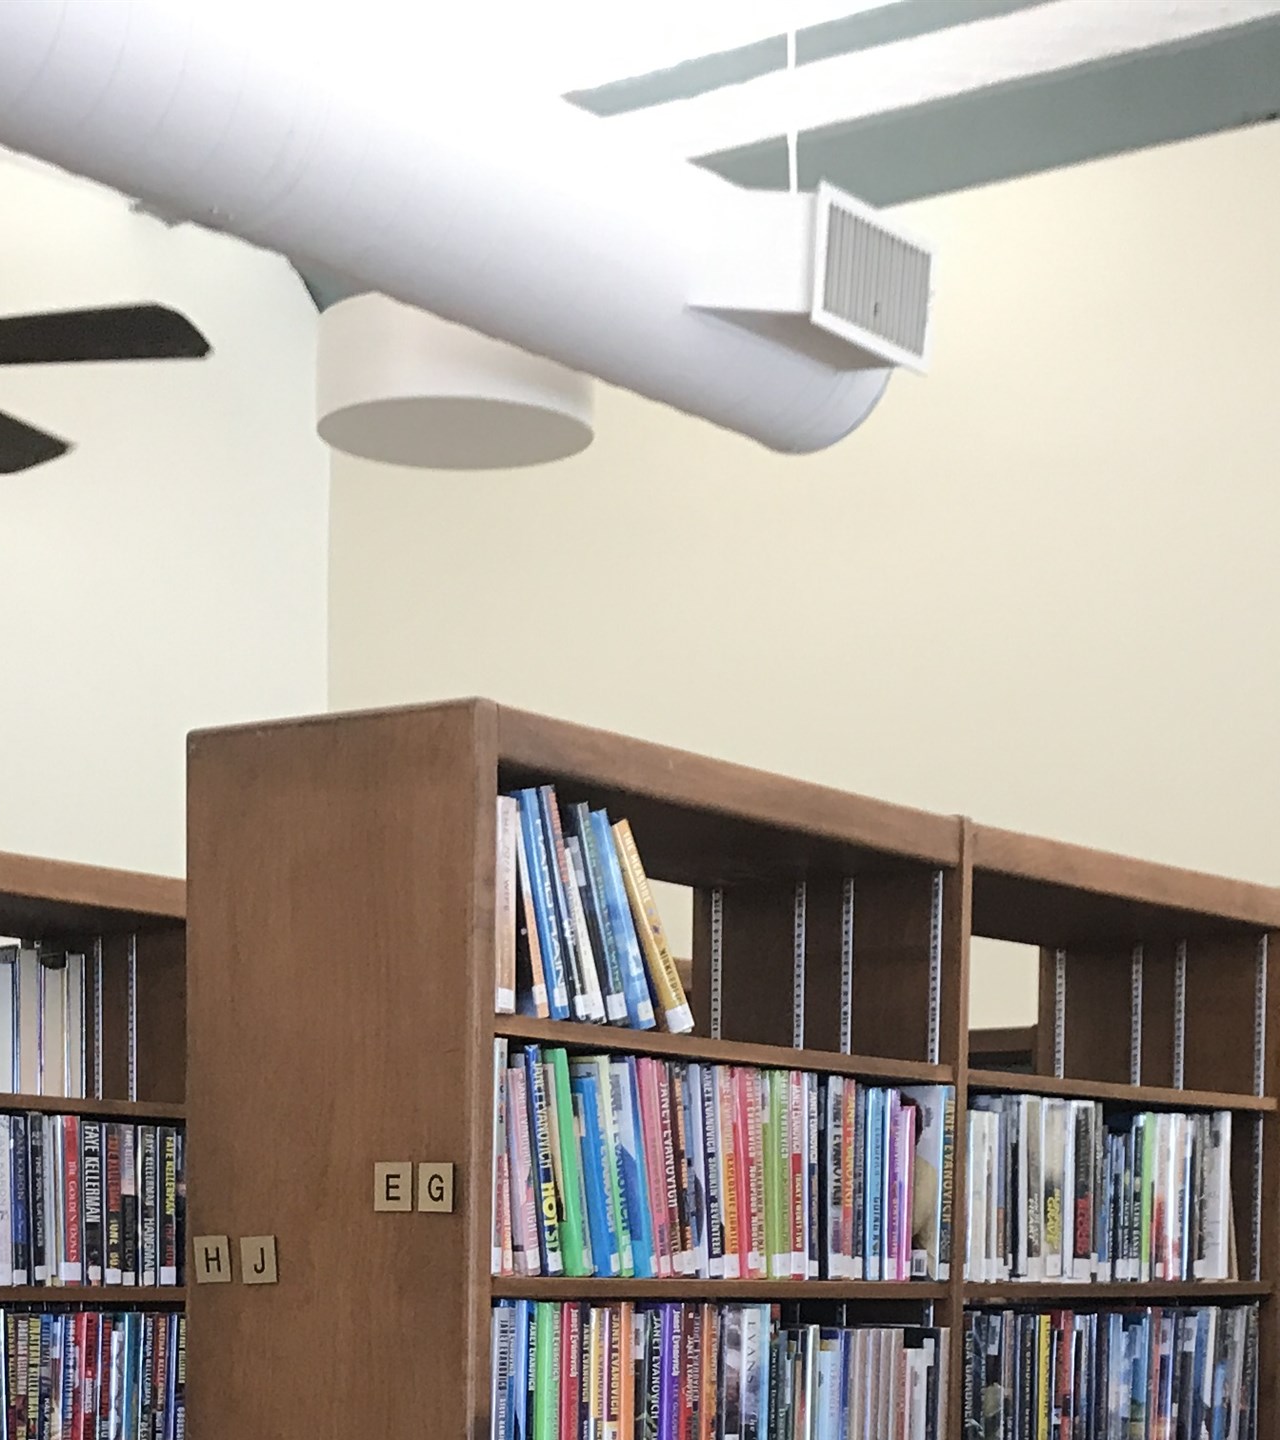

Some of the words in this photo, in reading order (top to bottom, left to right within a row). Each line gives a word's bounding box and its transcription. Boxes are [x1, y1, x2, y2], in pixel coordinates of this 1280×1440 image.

[624, 832, 634, 851] THE
[630, 854, 650, 903] MEASURE
[536, 819, 556, 908] HARD
[548, 916, 564, 986] RAIN
[532, 1062, 545, 1097] JANET
[703, 1068, 714, 1096] JANET
[659, 1081, 670, 1124] JANET
[809, 1091, 817, 1116] JANET
[85, 1126, 98, 1152] FAYE
[145, 1134, 153, 1153] FAYE
[166, 1137, 174, 1158] FAYE
[536, 1101, 552, 1168] EVANOVICH
[705, 1103, 716, 1153] EVANOVICH
[0, 1161, 8, 1206] KARON
[85, 1157, 100, 1222] KELLERMAN
[145, 1157, 155, 1206] KELLERMAN
[166, 1161, 175, 1215] KELLERMAN
[386, 1174, 401, 1201] E
[428, 1174, 444, 1202] G
[664, 1130, 677, 1208] EVANOVICH
[749, 1166, 757, 1214] Notorious
[846, 1137, 854, 1207] EVANOVICH
[943, 1145, 955, 1222] EVANOVICH
[68, 1181, 77, 1221] GOLDEN
[542, 1182, 555, 1224] HOT
[1047, 1196, 1055, 1242] GRAVE
[710, 1203, 721, 1254] SEVENTEEN
[205, 1247, 222, 1273] H
[254, 1247, 265, 1274] J
[28, 1318, 39, 1364] JONATHAN
[157, 1318, 165, 1356] JONATHAN
[500, 1321, 508, 1344] JANET
[570, 1309, 578, 1332] Janet
[653, 1316, 661, 1350] JANET
[570, 1335, 578, 1377] Evanovich
[672, 1336, 680, 1376] Evanovich
[747, 1321, 757, 1384] EVANS
[965, 1330, 973, 1357] LISA
[499, 1347, 508, 1390] EVANOVICH
[582, 1353, 590, 1402] EVANOVICH
[651, 1356, 660, 1419] EVANOVICH
[28, 1367, 40, 1419] KELLERMAN
[964, 1364, 974, 1427] GARDNER
